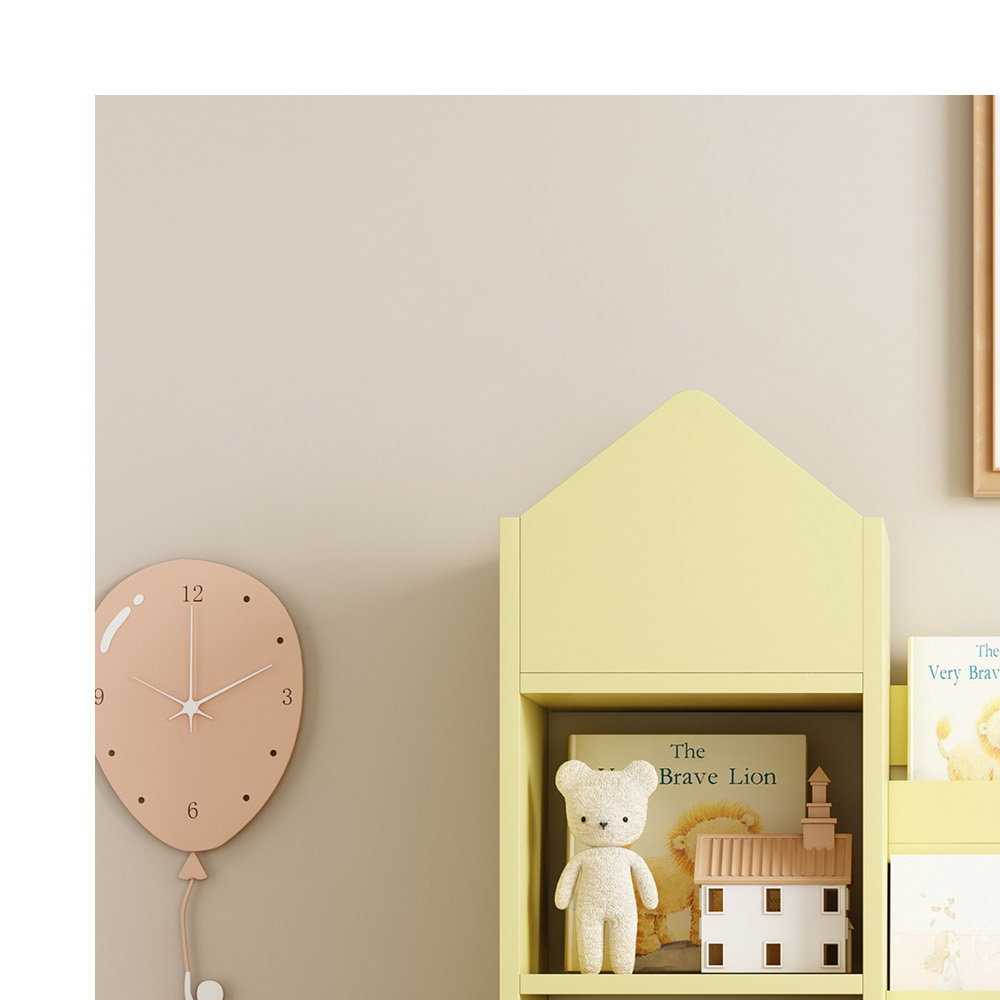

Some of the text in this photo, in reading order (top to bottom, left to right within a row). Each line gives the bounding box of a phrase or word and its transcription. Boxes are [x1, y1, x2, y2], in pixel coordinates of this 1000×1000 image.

[182, 585, 204, 603] 12
[976, 643, 1000, 658] The
[928, 665, 961, 686] Very
[95, 687, 104, 706] 9
[282, 687, 293, 706] 3
[670, 742, 706, 759] The
[660, 767, 777, 785] Brave Lion
[187, 801, 199, 819] 6
